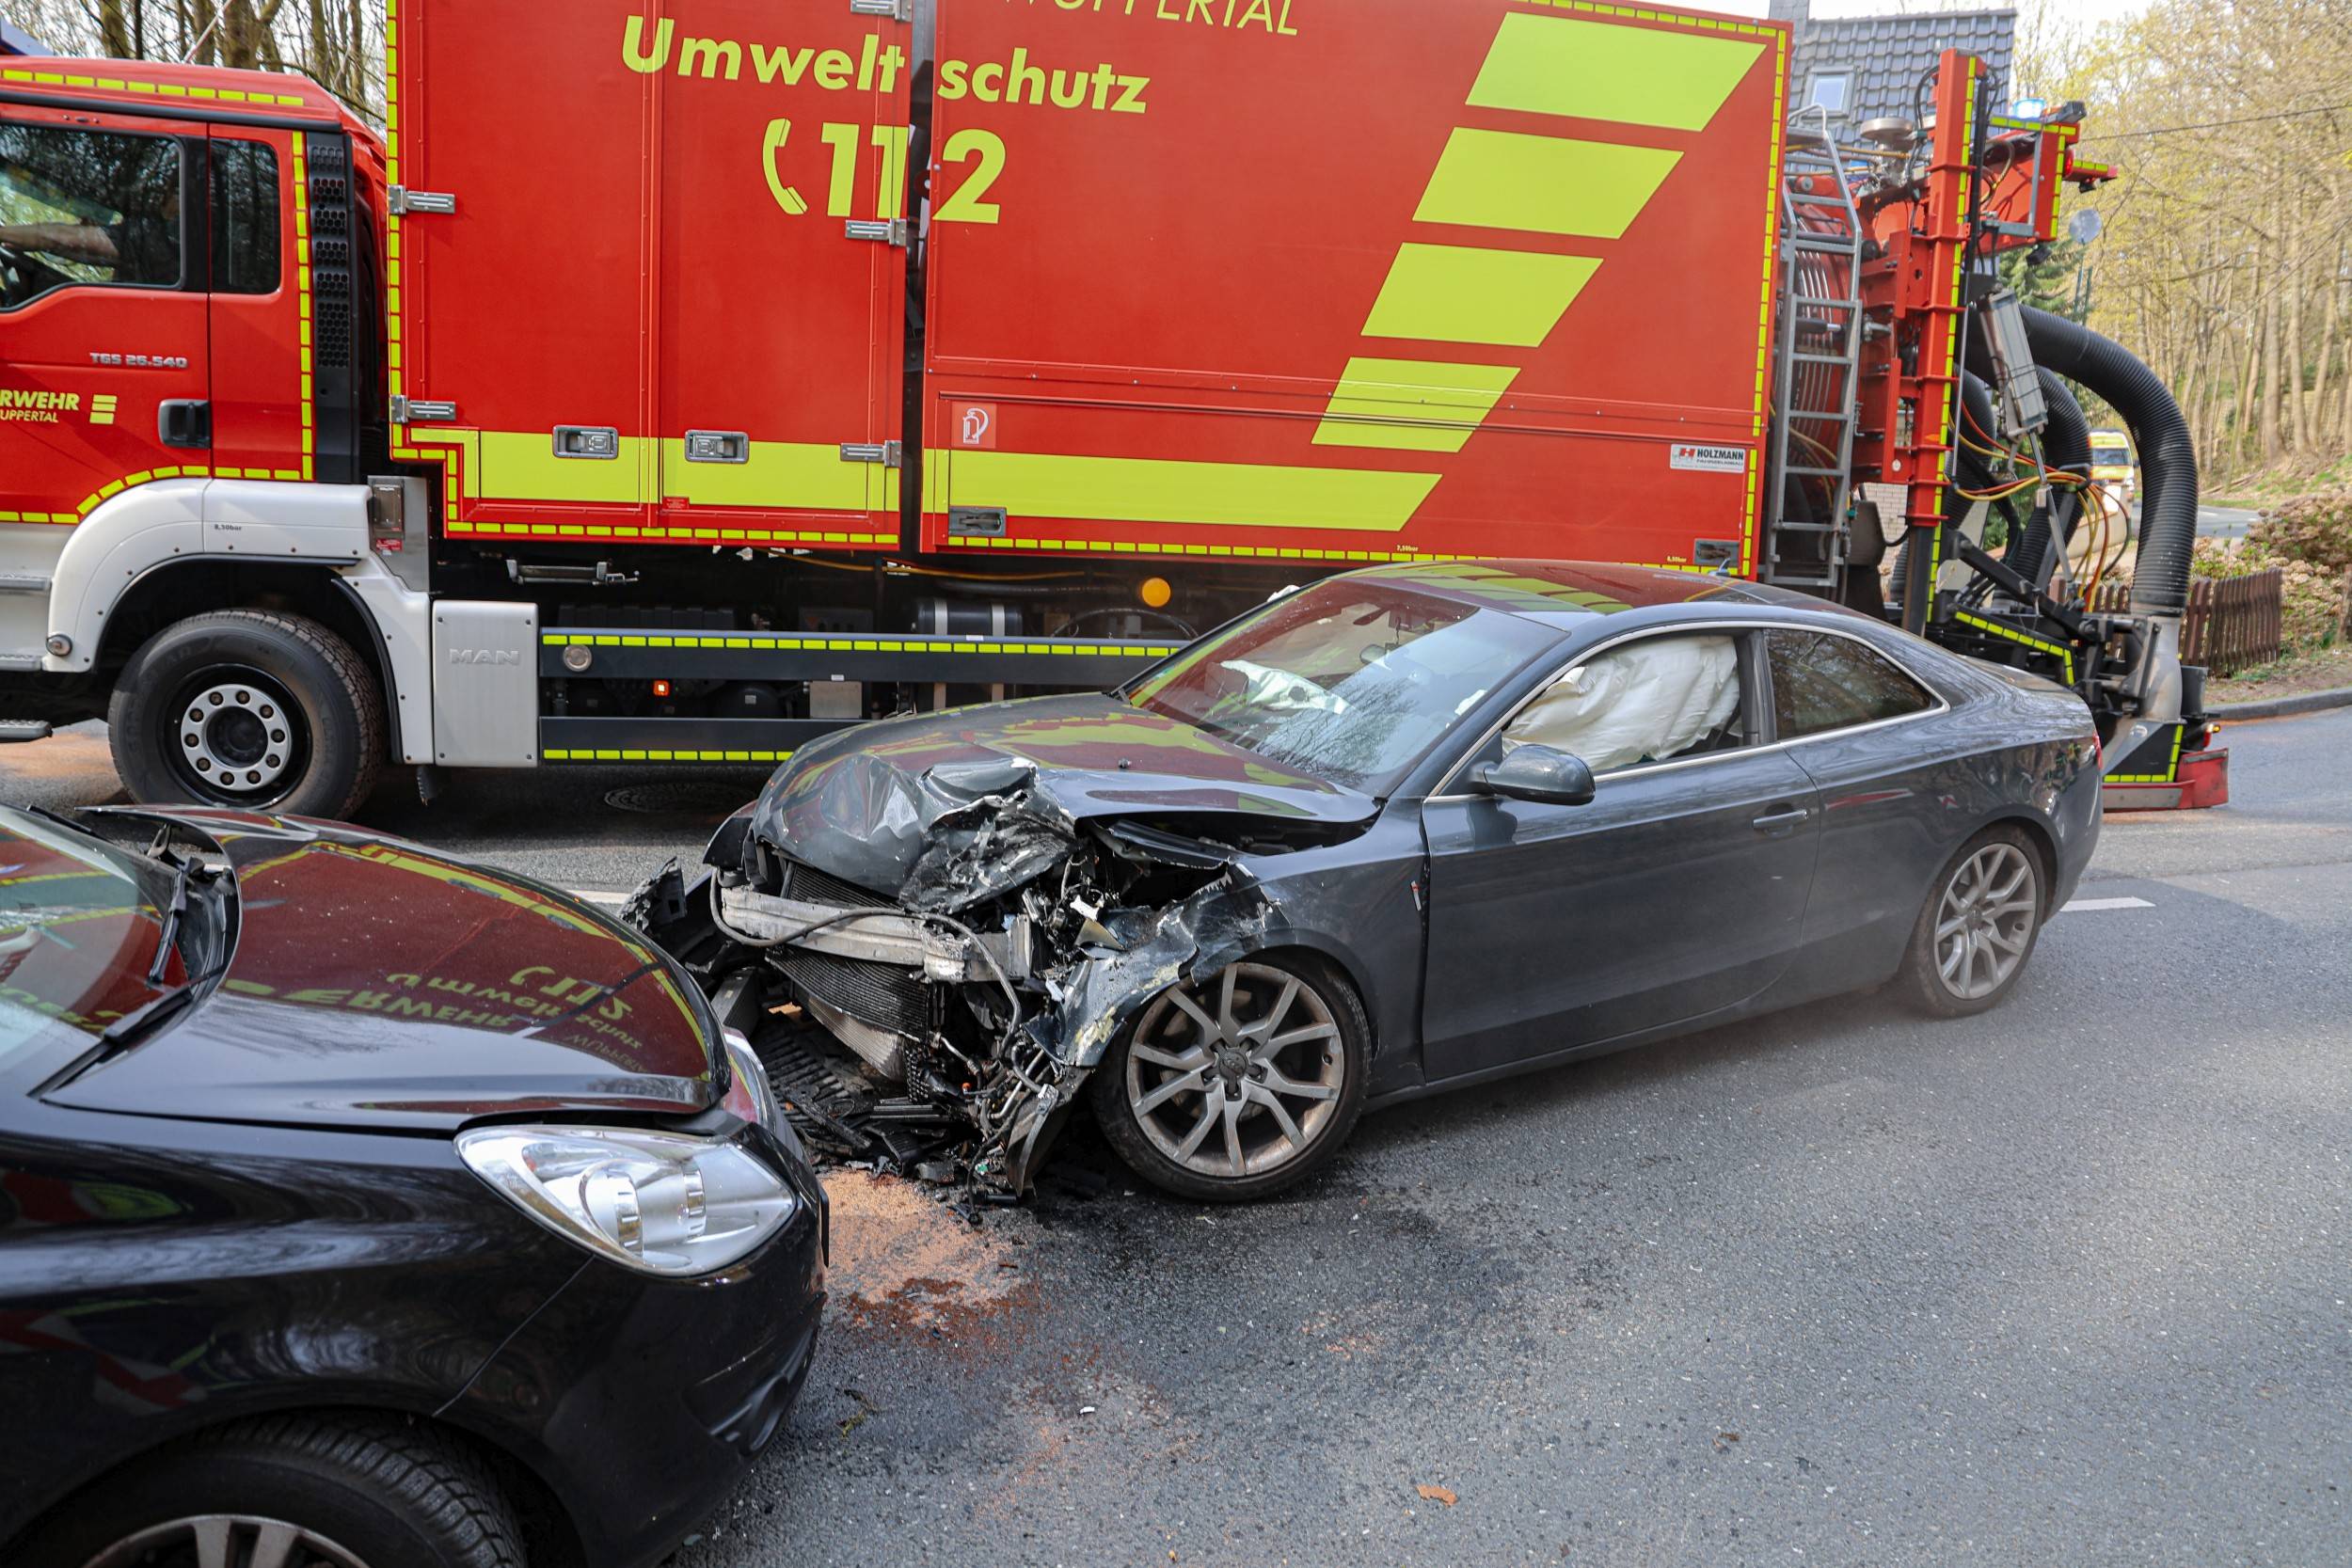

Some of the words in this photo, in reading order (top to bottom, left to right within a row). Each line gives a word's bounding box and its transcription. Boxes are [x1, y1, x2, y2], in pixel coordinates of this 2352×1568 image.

[623, 15, 904, 92] Umwelt
[938, 48, 1151, 114] schutz
[819, 122, 1007, 224] 112
[89, 353, 121, 365] TGS
[125, 354, 188, 368] 26.540
[0, 389, 80, 410] RWEHR
[1696, 448, 1744, 460] HOLZMANN
[450, 648, 519, 665] MAN
